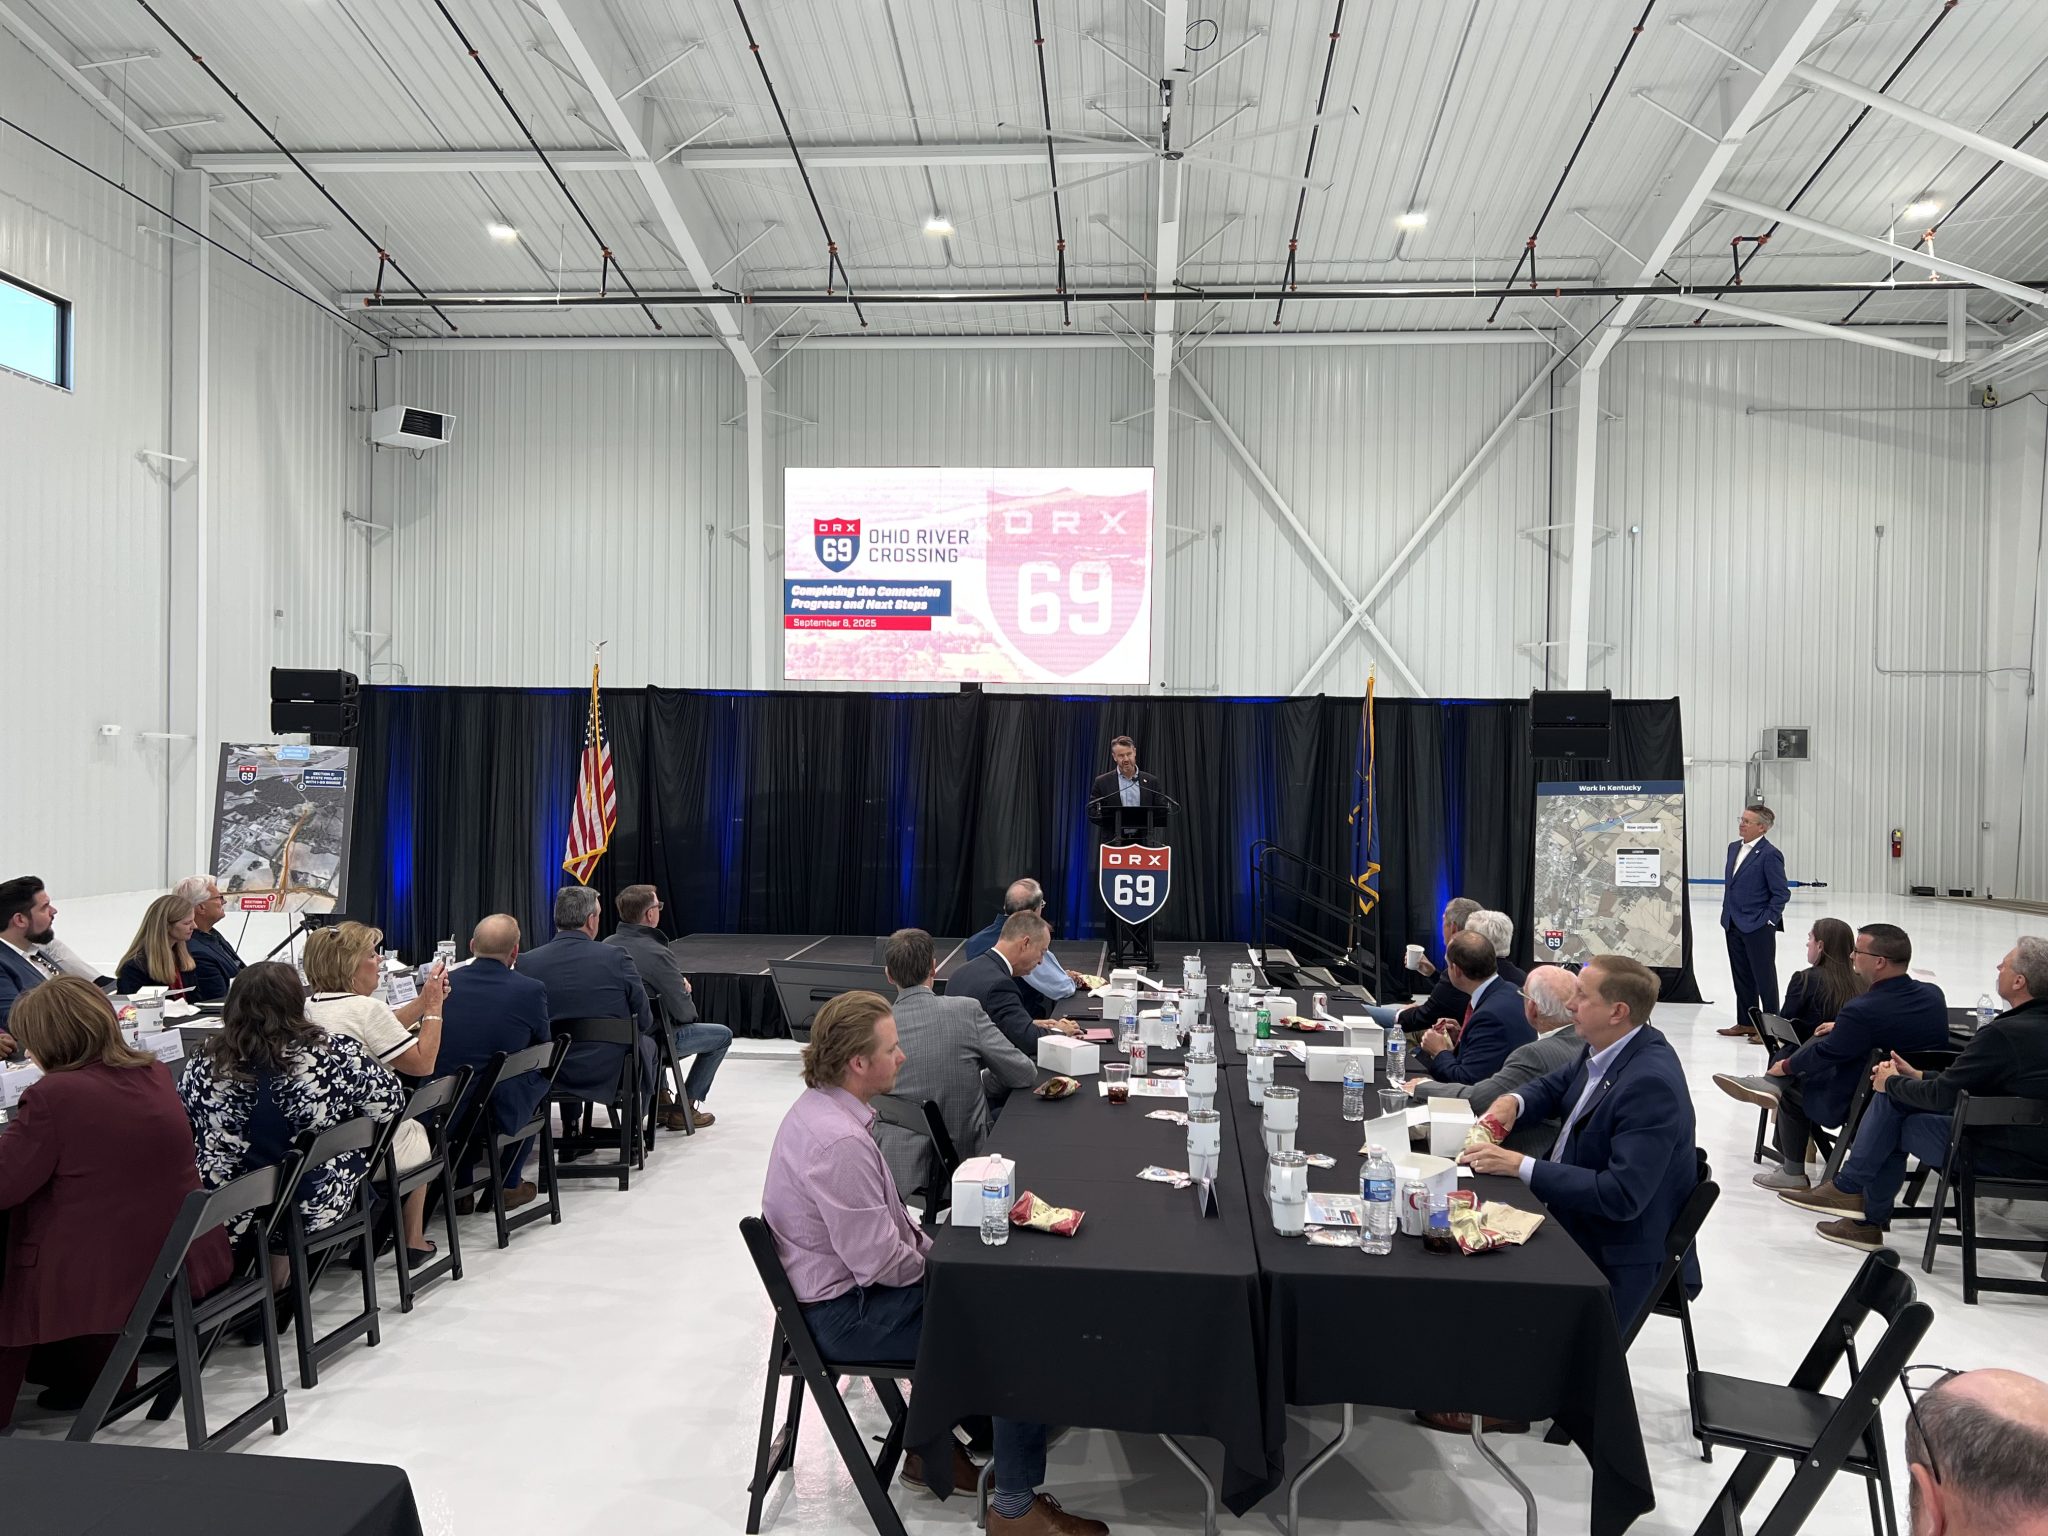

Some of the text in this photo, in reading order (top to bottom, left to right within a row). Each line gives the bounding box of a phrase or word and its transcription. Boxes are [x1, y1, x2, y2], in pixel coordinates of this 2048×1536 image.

[819, 523, 856, 533] ORX
[1004, 510, 1127, 535] ORX
[869, 529, 970, 545] OHIO RIVER
[822, 538, 853, 562] 69
[869, 548, 959, 563] CROSSING
[791, 585, 941, 598] Completing the Connection
[791, 599, 928, 611] Progress and Next Steps
[1017, 561, 1113, 636] 69
[793, 618, 877, 628] September 8, 2025
[241, 772, 254, 781] 69
[1607, 784, 1642, 792] Kentucky
[1108, 853, 1162, 866] ORX
[1114, 874, 1155, 906] 69
[1548, 937, 1561, 947] 69
